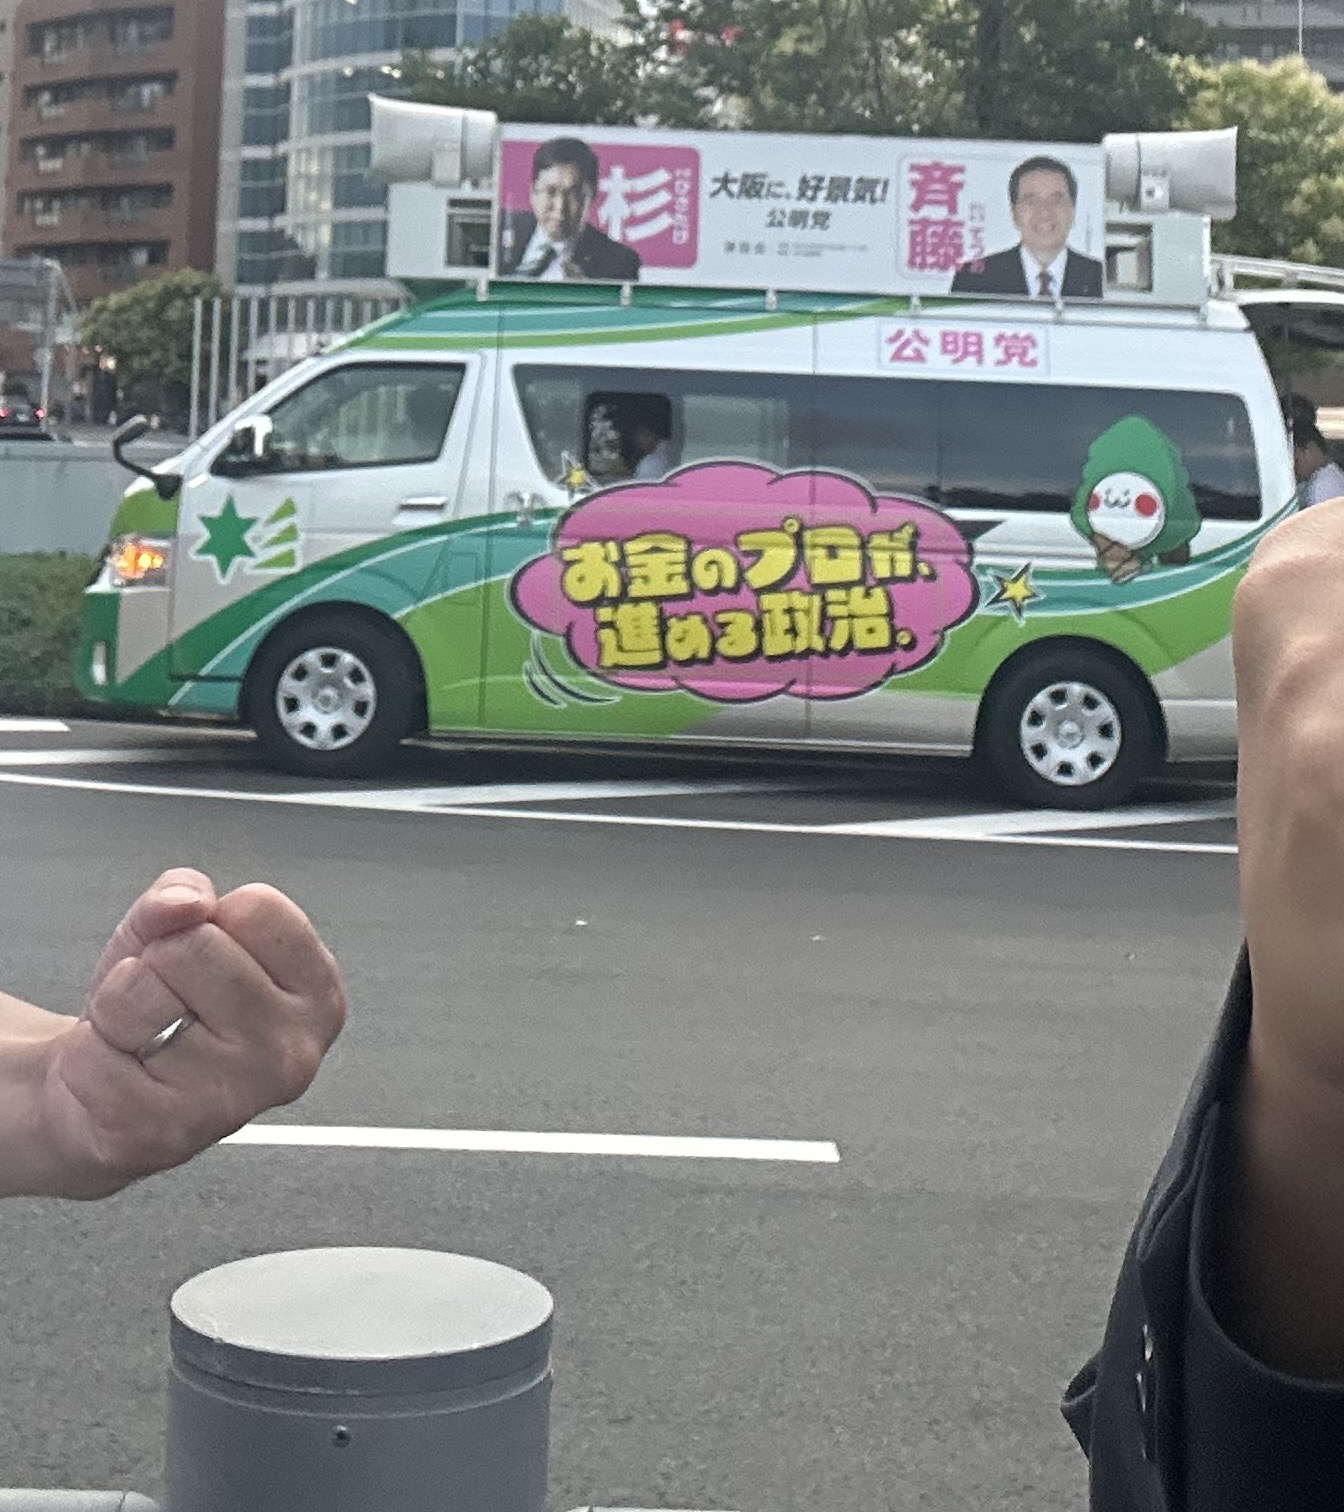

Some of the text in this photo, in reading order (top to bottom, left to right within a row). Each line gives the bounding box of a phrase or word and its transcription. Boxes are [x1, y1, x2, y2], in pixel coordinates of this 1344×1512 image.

[598, 164, 673, 242] 杉
[765, 207, 833, 231] 公明党
[907, 160, 967, 272] 斉藤
[885, 327, 1039, 368] 公明党
[560, 515, 937, 605] お金のプロが、
[594, 585, 916, 670] 進める政治。
